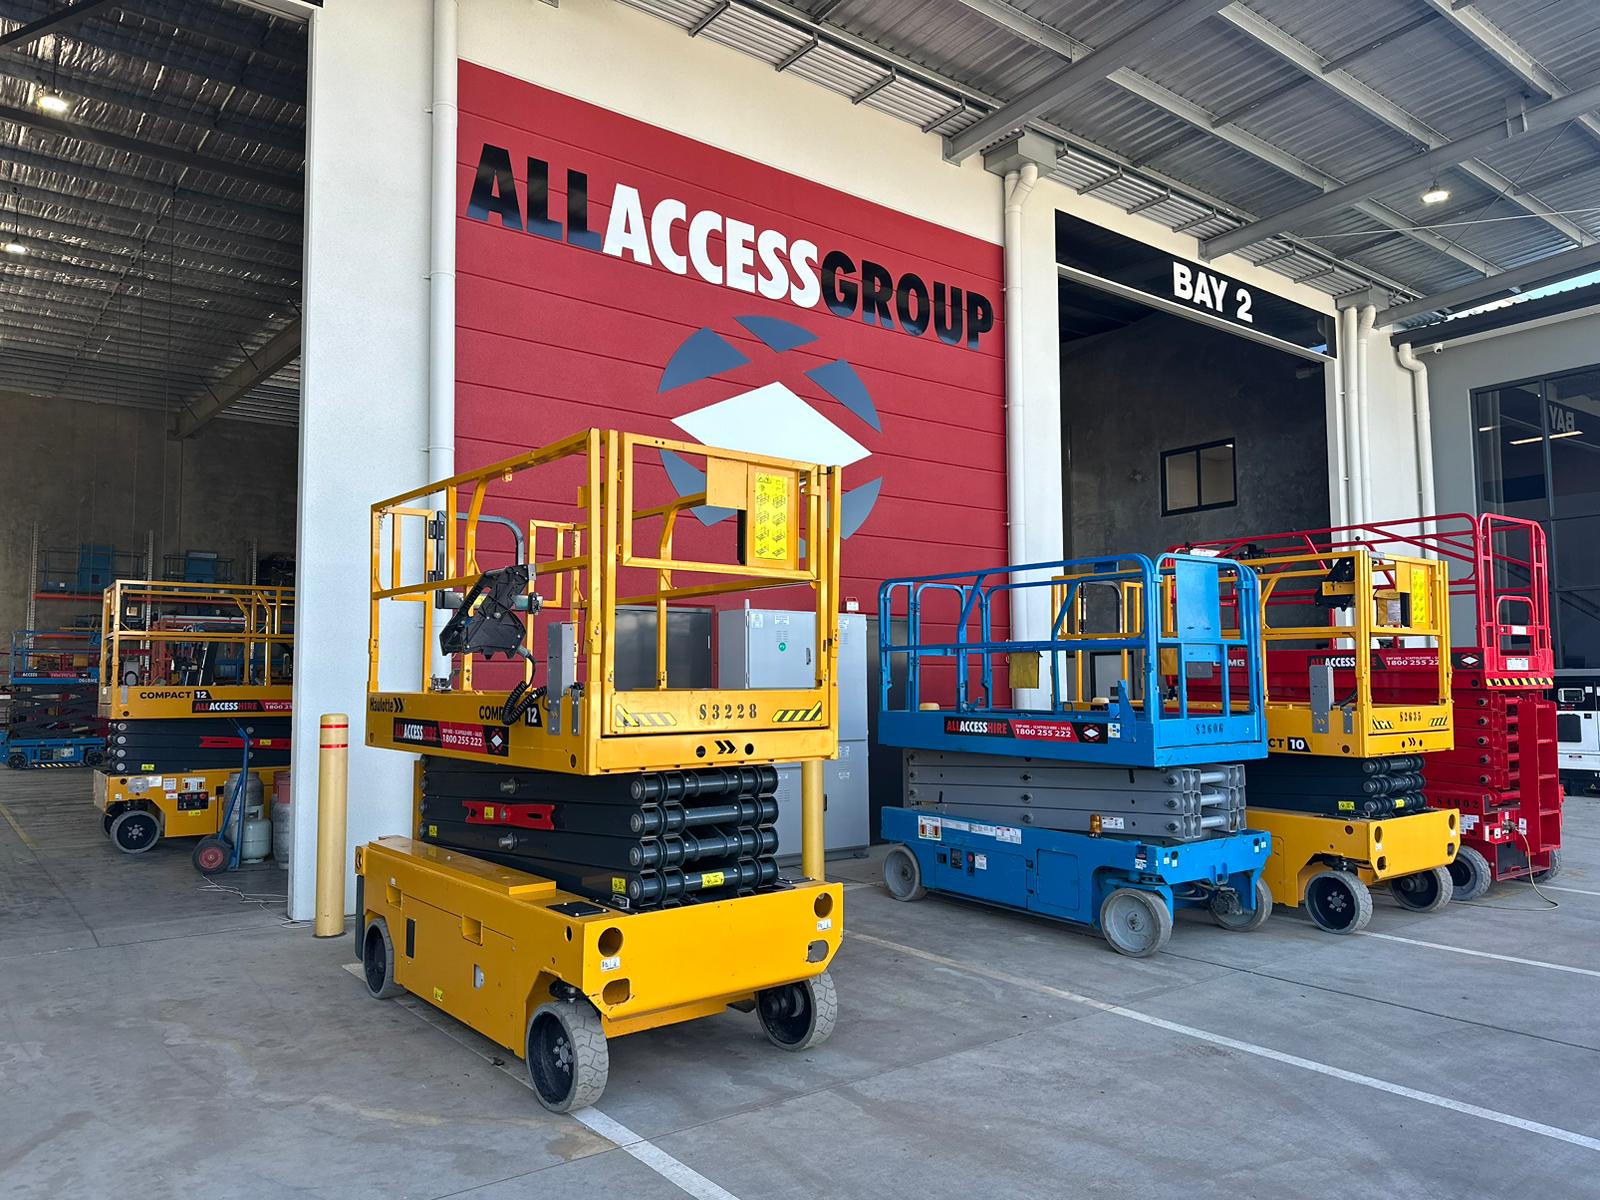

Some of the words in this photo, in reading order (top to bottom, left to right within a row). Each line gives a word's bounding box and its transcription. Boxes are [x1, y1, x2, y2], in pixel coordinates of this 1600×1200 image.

[1173, 261, 1228, 313] BAY
[1236, 288, 1253, 323] 2
[1213, 659, 1245, 667] LMG
[140, 691, 192, 699] COMPACT
[196, 691, 207, 699] 12
[527, 707, 538, 723] 12
[699, 703, 757, 720] S3228
[1037, 729, 1053, 737] 255
[1055, 730, 1071, 738] 222
[442, 734, 457, 744] 1800
[457, 735, 469, 745] 255
[470, 737, 482, 747] 222
[1268, 738, 1284, 748] CT
[1289, 739, 1305, 750] 10
